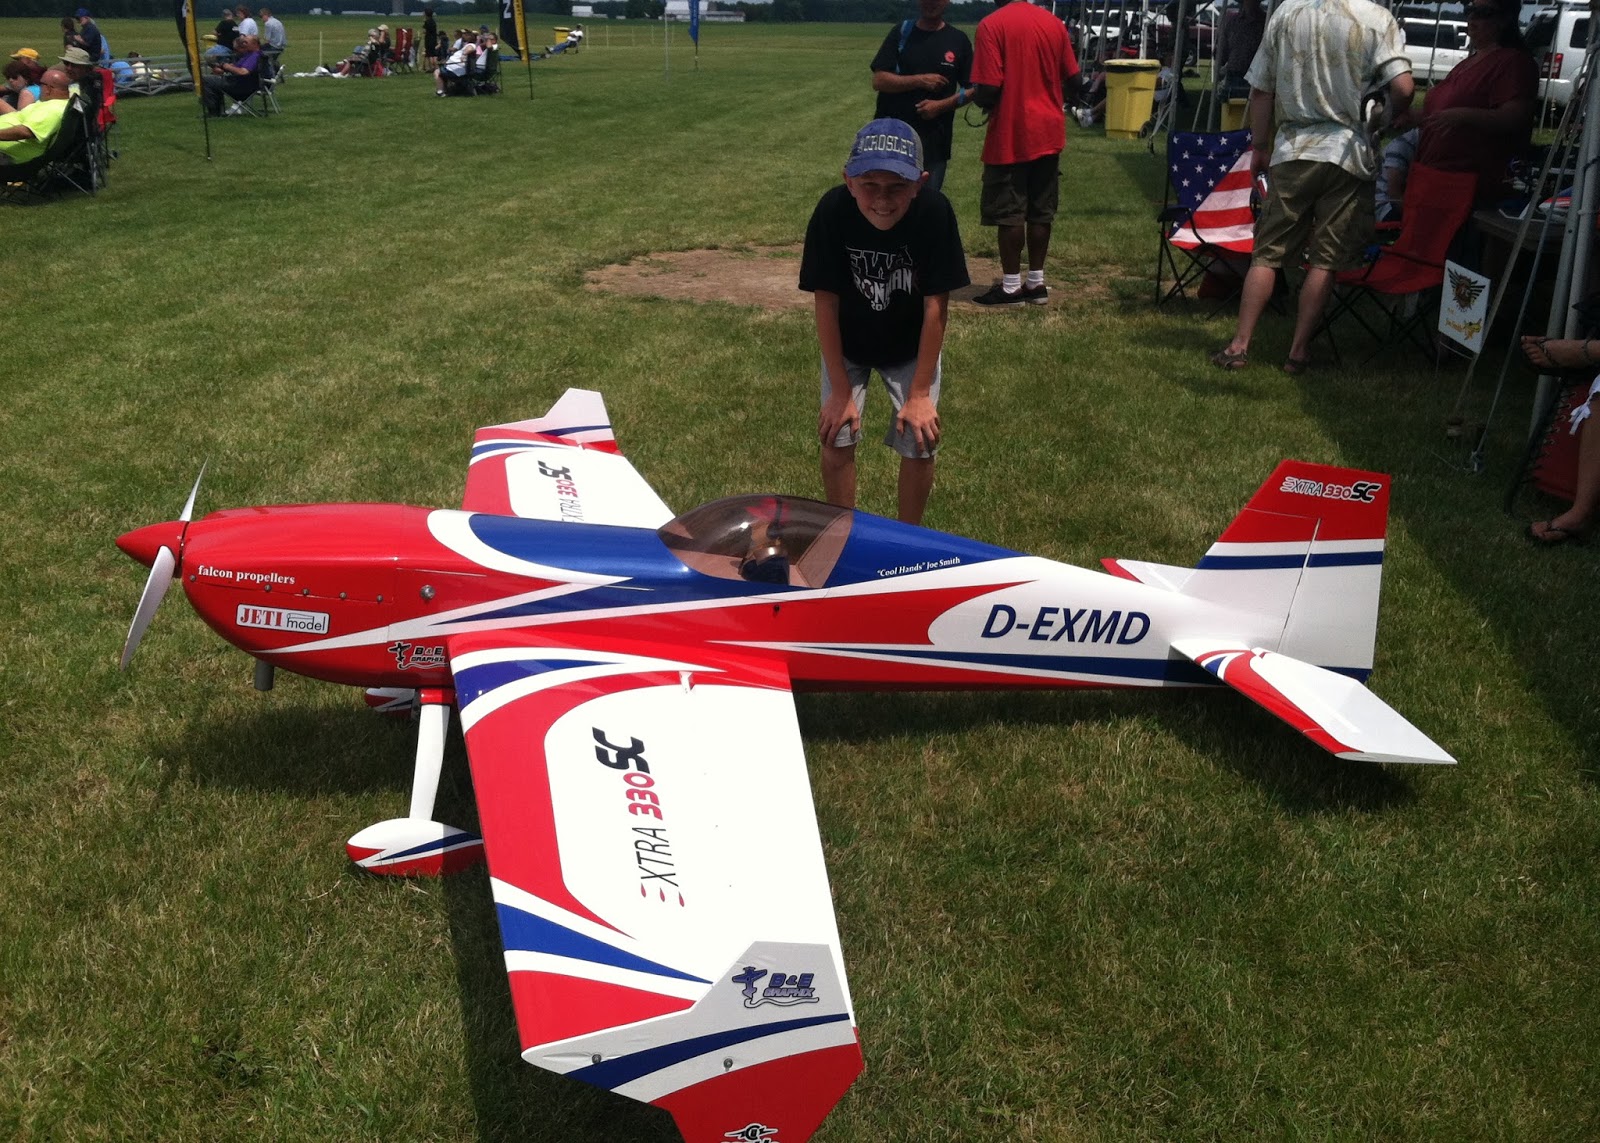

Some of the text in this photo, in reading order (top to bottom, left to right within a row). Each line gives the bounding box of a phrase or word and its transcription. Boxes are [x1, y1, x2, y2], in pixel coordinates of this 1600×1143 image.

[1280, 476, 1323, 496] EXTRA
[926, 561, 939, 571] Joe
[939, 556, 961, 567] Smith
[198, 565, 296, 585] falcon propellers
[240, 607, 327, 631] JETI model
[980, 603, 1151, 646] D-EXMD
[631, 827, 685, 908] EXTRA
